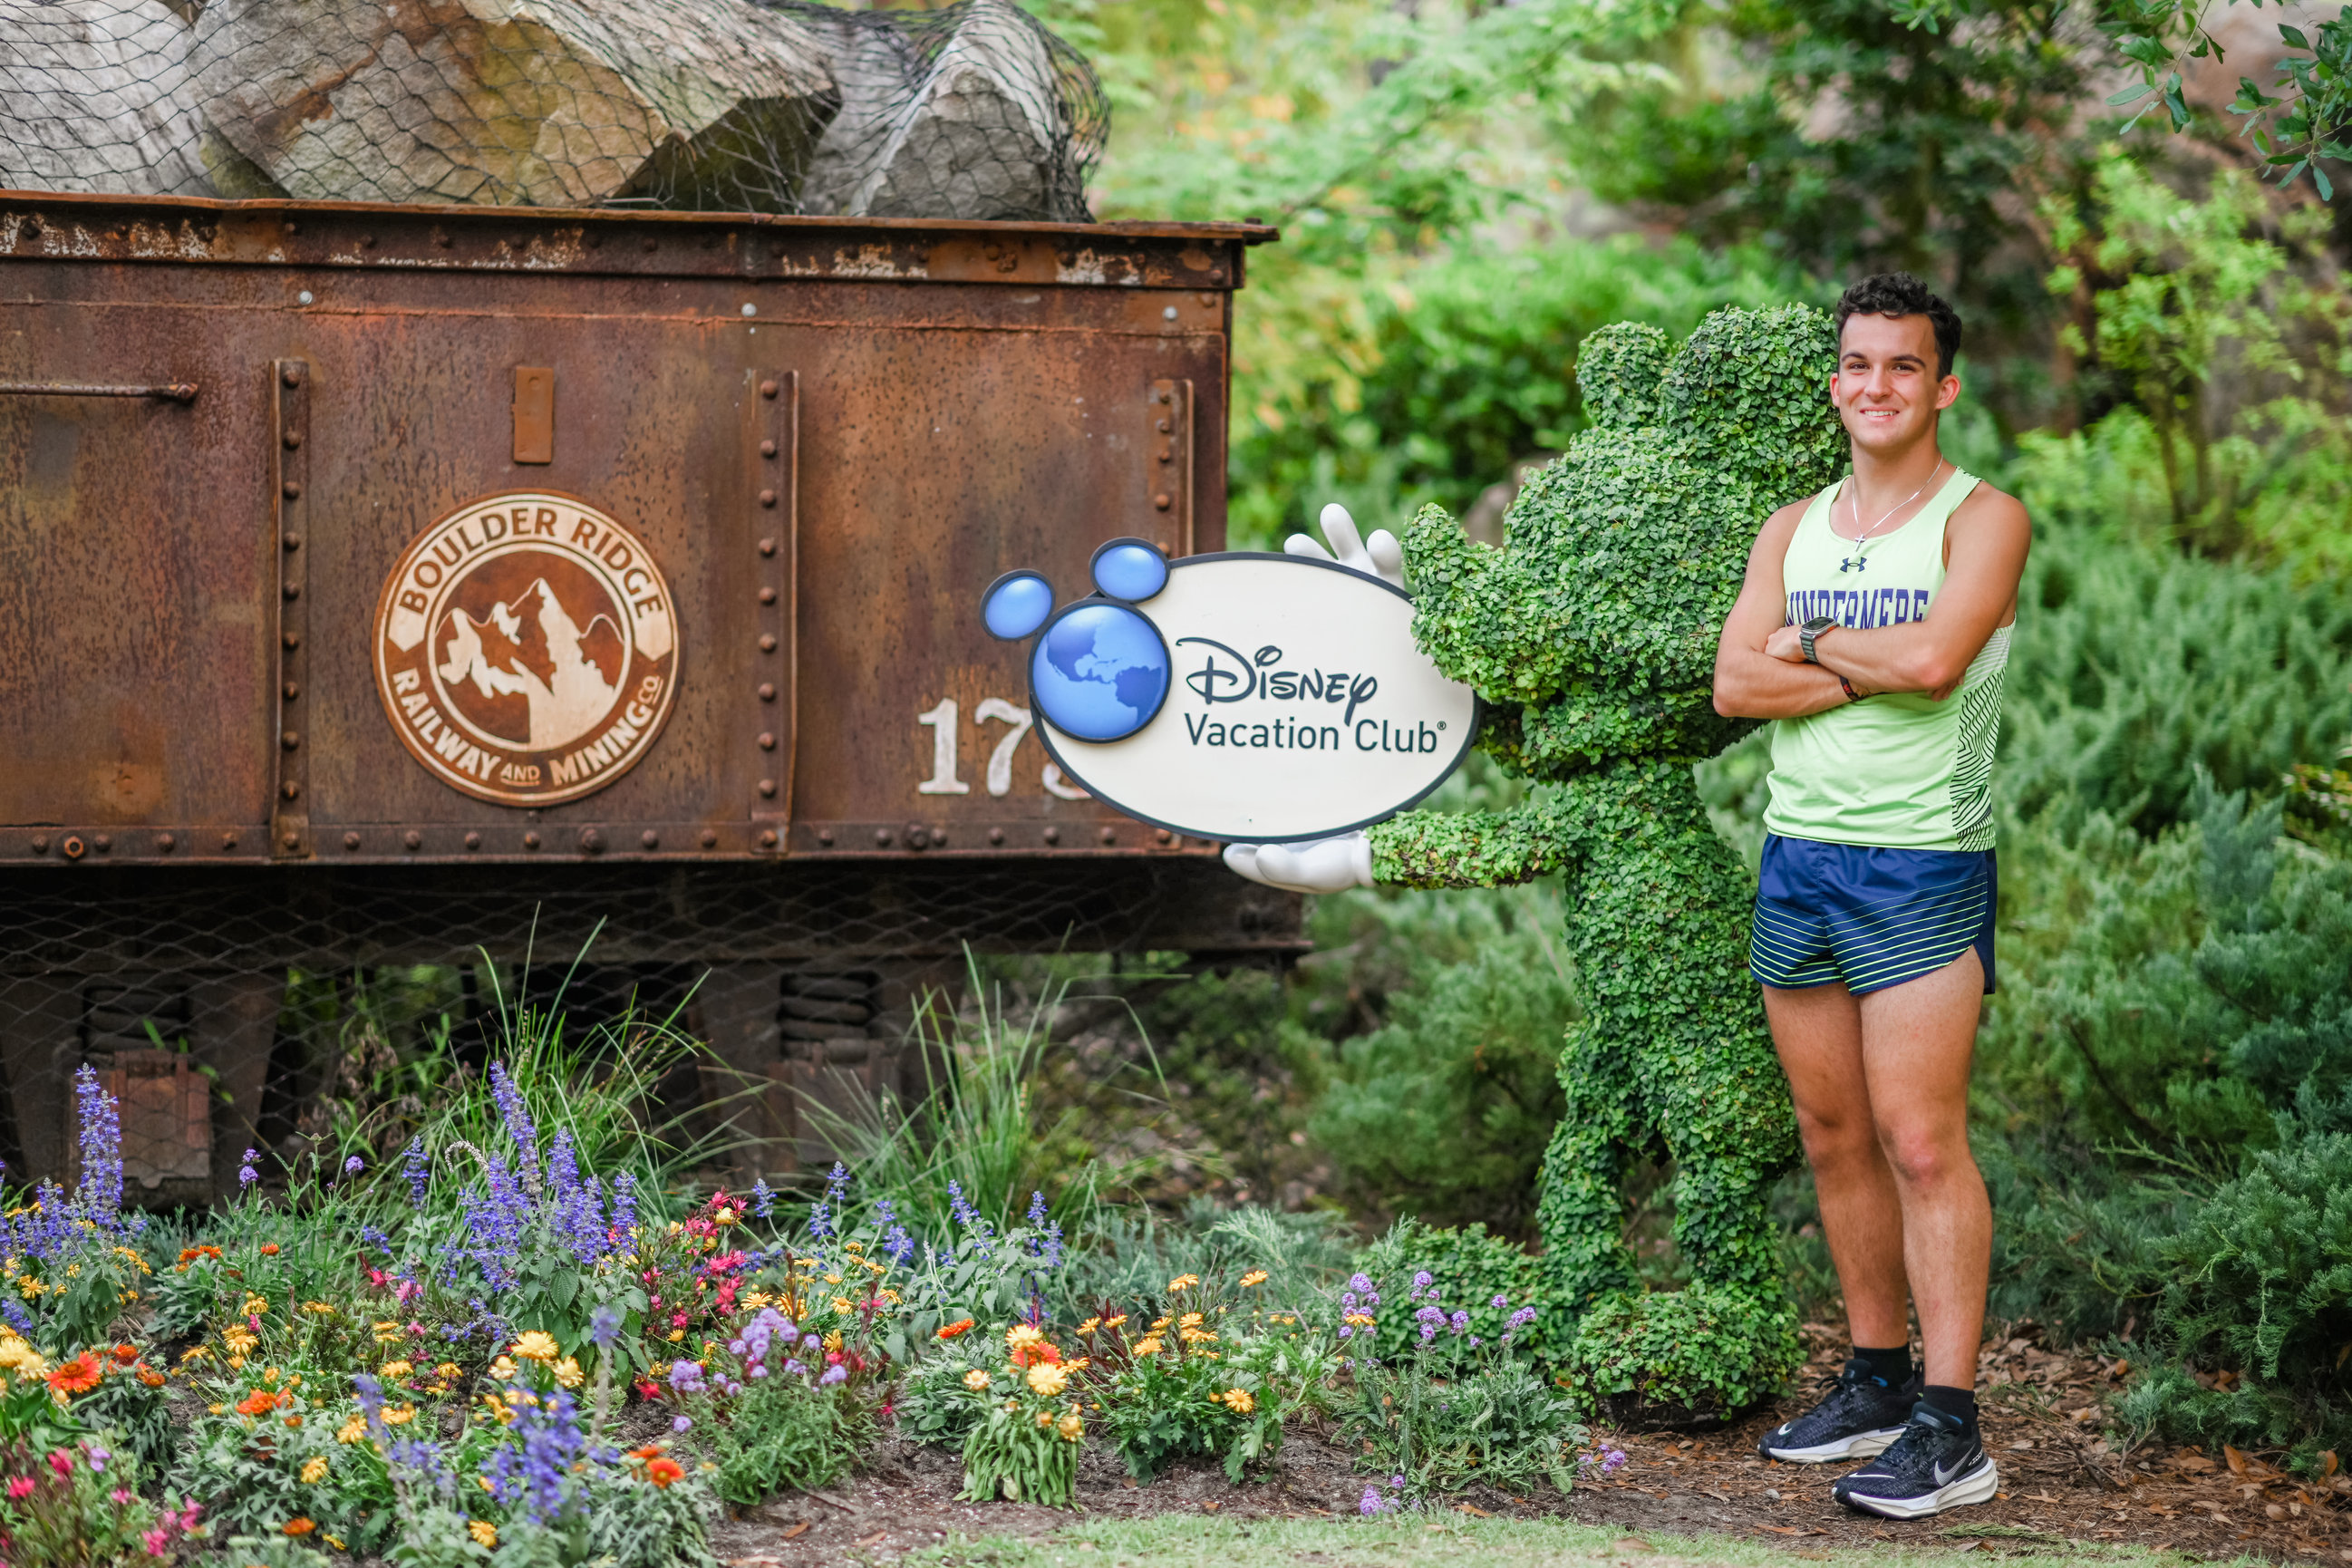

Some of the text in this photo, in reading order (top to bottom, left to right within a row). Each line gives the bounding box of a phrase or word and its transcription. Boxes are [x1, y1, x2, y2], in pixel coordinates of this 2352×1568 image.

[399, 508, 663, 619] BOULDER RIDGE
[392, 667, 501, 781] RAILWAY
[500, 762, 541, 784] AND
[548, 701, 653, 787] MINING
[1184, 712, 1340, 750] Vacation
